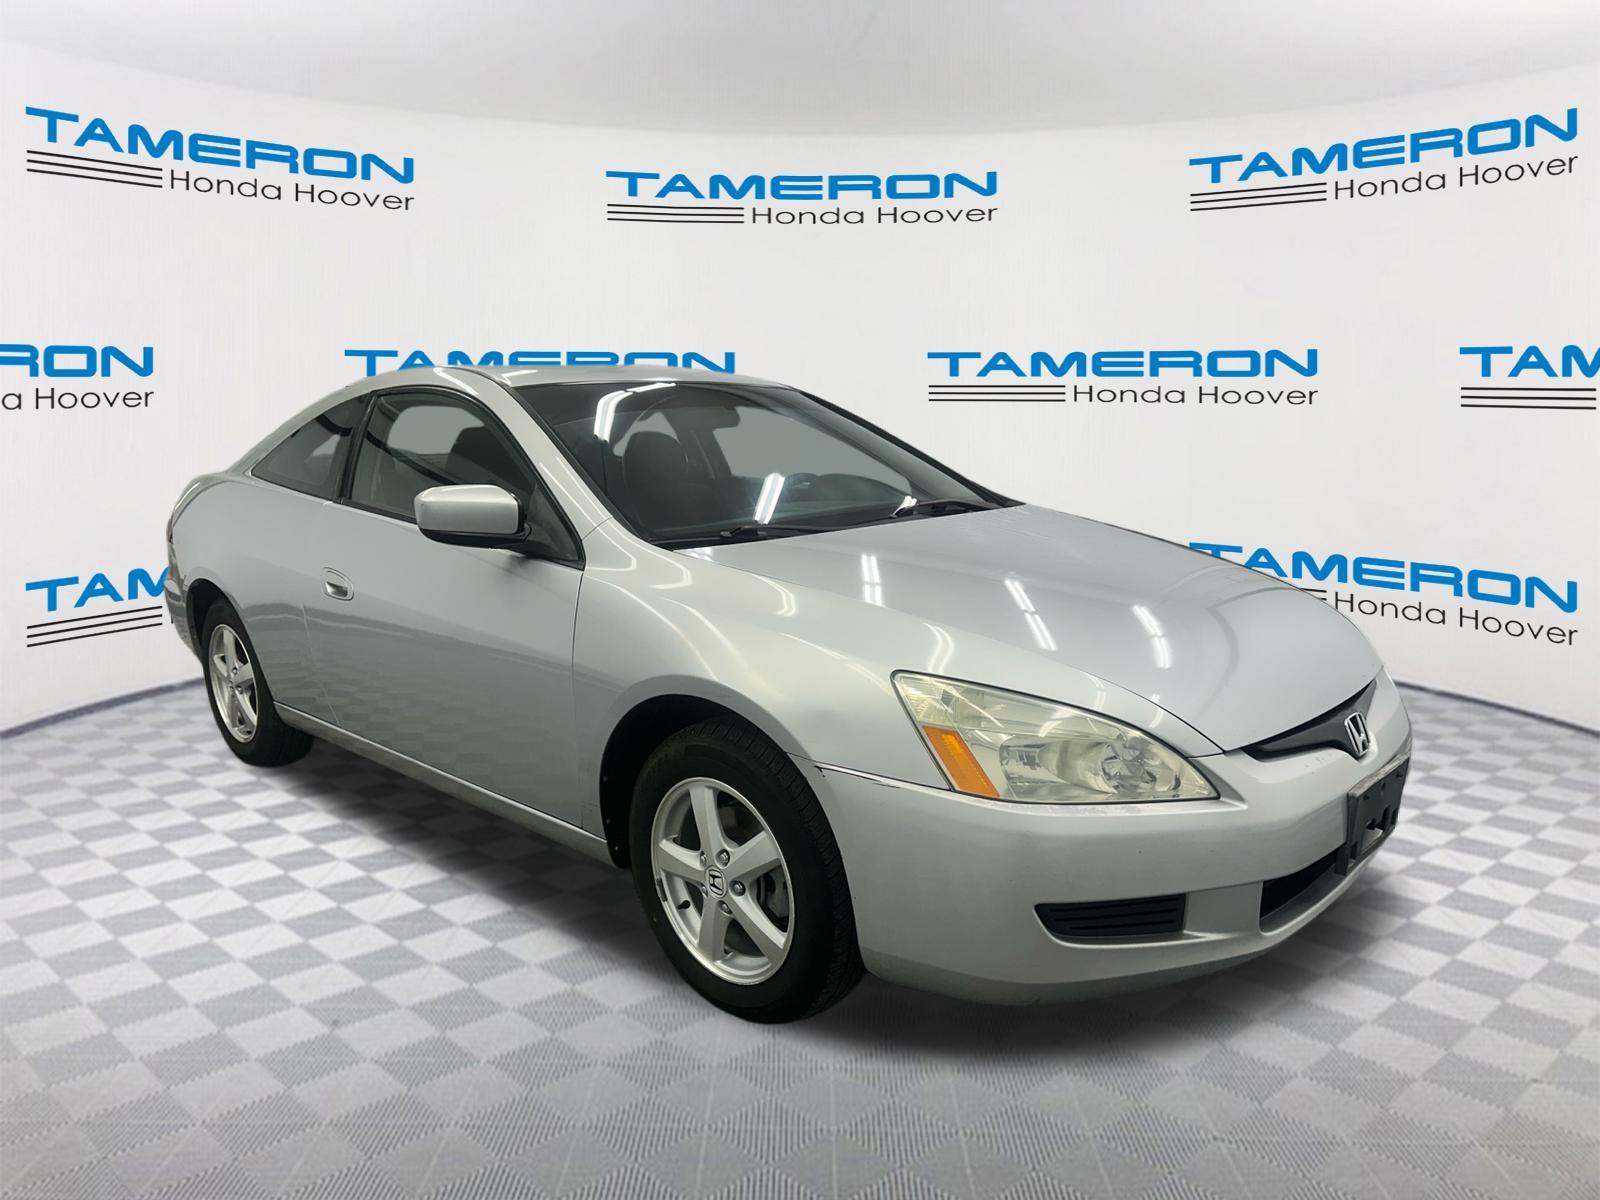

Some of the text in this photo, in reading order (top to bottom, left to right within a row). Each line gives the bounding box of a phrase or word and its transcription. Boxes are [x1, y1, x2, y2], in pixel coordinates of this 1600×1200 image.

[25, 106, 414, 184] TAMERON
[1188, 108, 1578, 184] TAMERON
[171, 169, 414, 210] Honda Hoover
[605, 171, 998, 200] TAMERON
[1335, 156, 1578, 199] Honda Hoover
[753, 207, 997, 224] Honda Hoover
[927, 348, 1318, 378] TAMERON
[36, 388, 154, 409] Hoover
[1074, 385, 1318, 404] Honda Hoover
[1188, 542, 1578, 613] TAMERON
[1335, 592, 1578, 645] Honda Hoover
